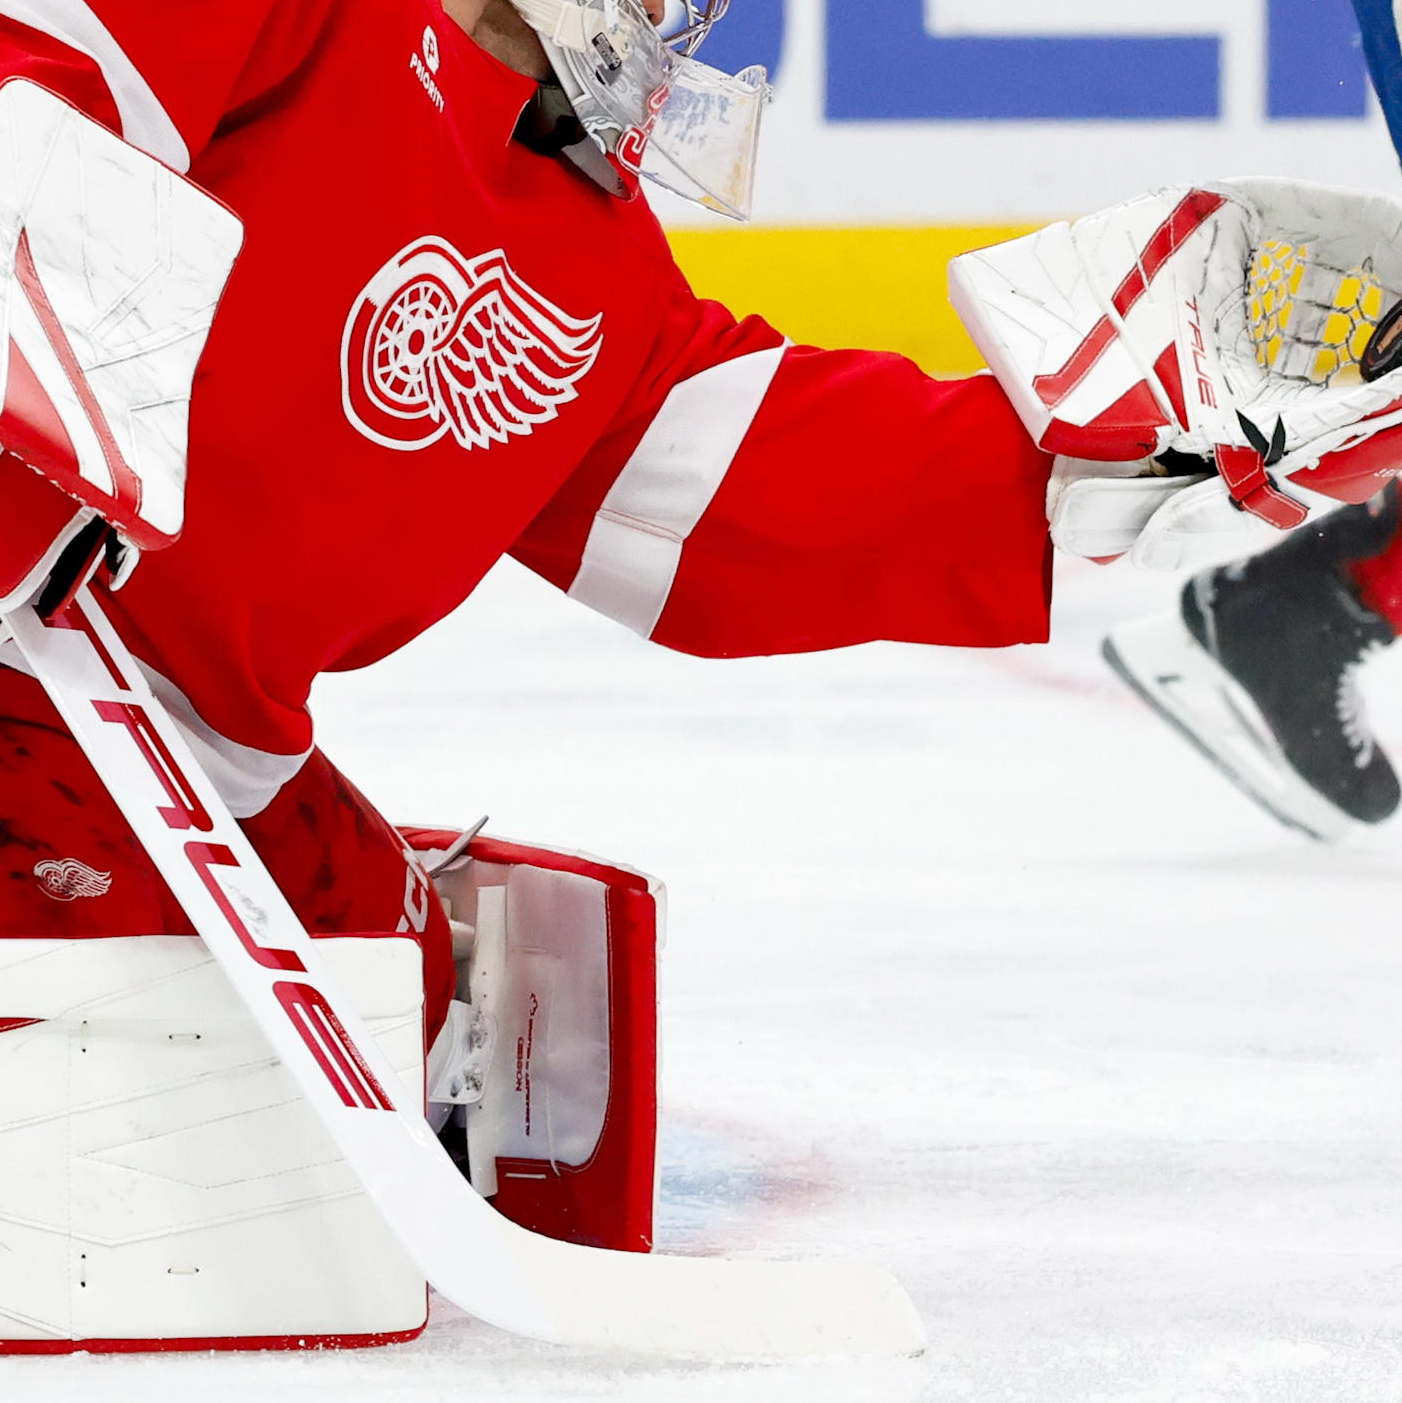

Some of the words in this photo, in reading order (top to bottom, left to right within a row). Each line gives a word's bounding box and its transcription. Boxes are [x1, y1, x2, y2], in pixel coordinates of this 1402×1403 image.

[409, 51, 445, 114] PRIORITY
[1184, 294, 1219, 410] TRUE
[31, 595, 397, 1113] TRUE
